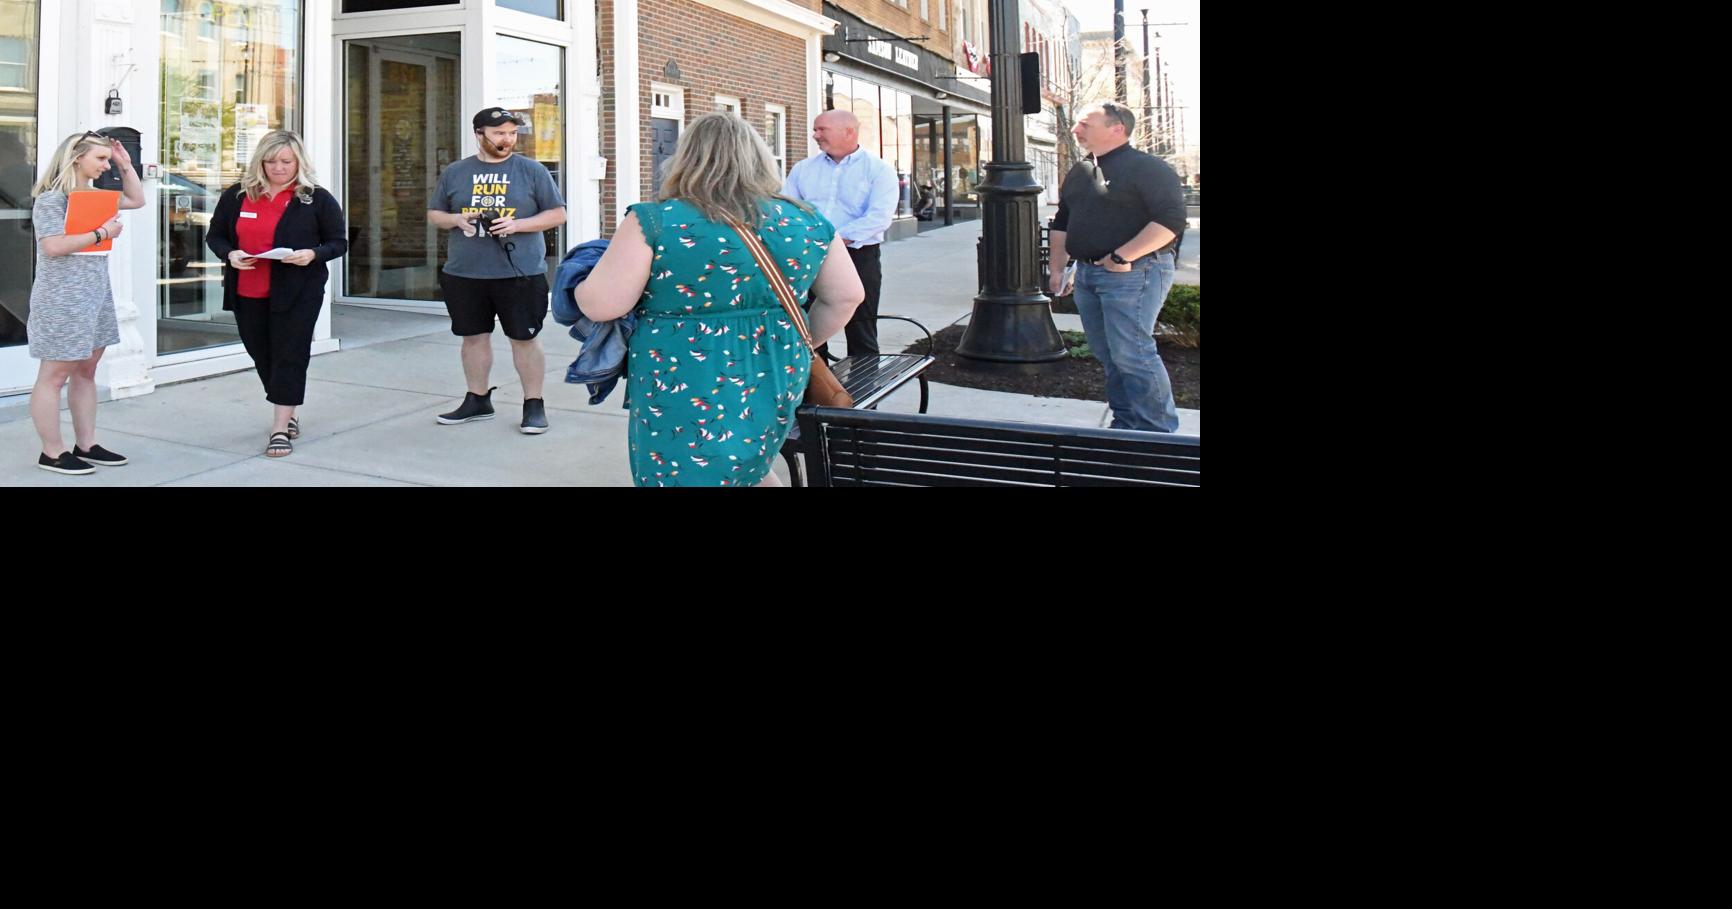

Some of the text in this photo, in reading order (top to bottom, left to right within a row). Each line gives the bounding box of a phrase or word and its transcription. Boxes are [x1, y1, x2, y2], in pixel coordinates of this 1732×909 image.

[472, 173, 510, 184] WILL
[472, 183, 507, 195] RUN
[471, 195, 506, 207] FOR
